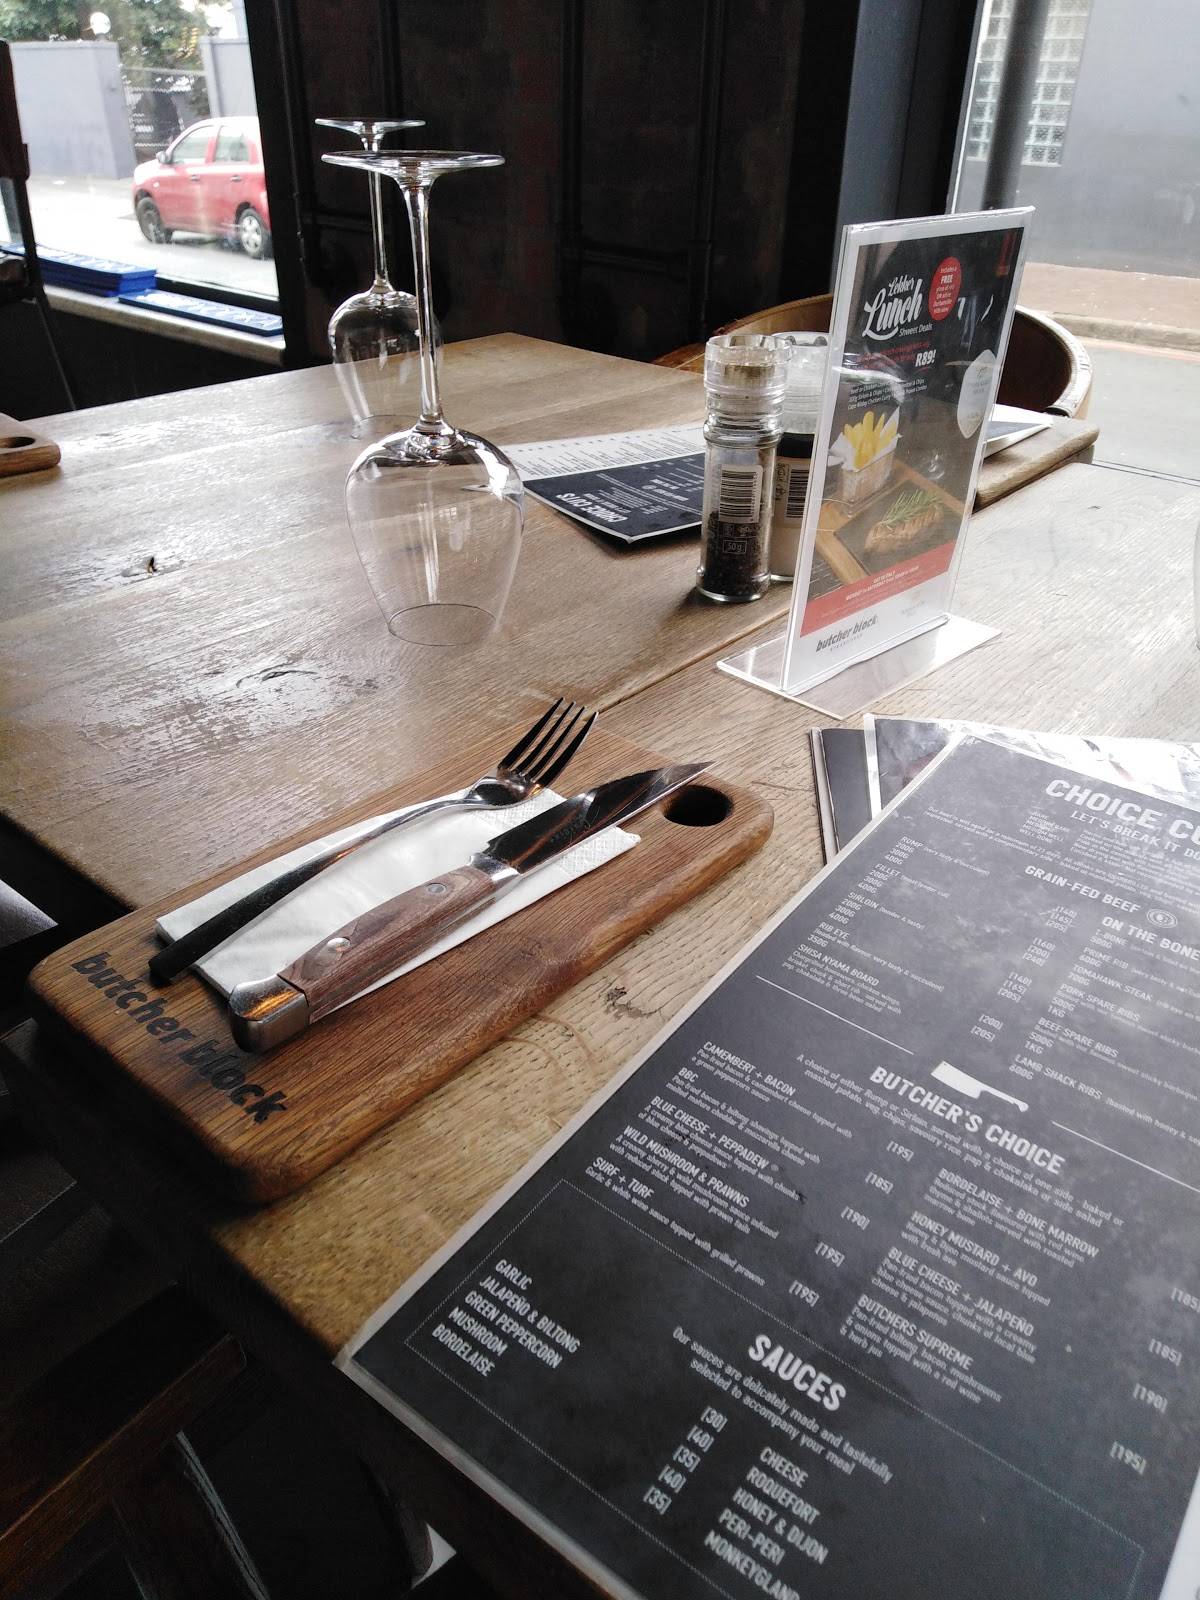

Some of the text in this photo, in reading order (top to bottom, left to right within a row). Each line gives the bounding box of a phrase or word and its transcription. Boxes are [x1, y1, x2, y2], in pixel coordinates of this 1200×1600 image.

[861, 278, 924, 341] Lunch
[915, 349, 937, 367] R89!
[815, 626, 852, 653] butcher
[853, 614, 878, 637] block
[1043, 777, 1163, 830] CHOICE
[900, 836, 923, 848] RUMP
[1069, 809, 1110, 829] LET'S
[1111, 823, 1160, 846] BREAK
[1163, 841, 1180, 853] IT
[874, 863, 900, 876] FILLET
[1023, 864, 1140, 915] GRAIN-FED BEEF
[847, 892, 879, 908] SIRLOIN
[818, 922, 849, 939] RIB EYE
[1101, 915, 1124, 931] ON
[1125, 924, 1157, 944] THE
[1159, 937, 1200, 961] BONE
[796, 944, 880, 986] SHISA NYAMA BOARD
[1086, 994, 1116, 1011] SPARE
[1118, 1007, 1140, 1021] RIBS
[1123, 985, 1152, 1002] STEAK
[70, 952, 288, 1124] butcher block
[1037, 1017, 1118, 1058] BEEF SPARE RIBS
[676, 1067, 698, 1083] BBC
[700, 1041, 755, 1074] CAMEMBERT
[762, 1074, 796, 1096] BACON
[1014, 1053, 1043, 1072] LAMB
[1078, 1083, 1103, 1100] RIBS
[649, 1095, 677, 1115] BLUE
[672, 1109, 710, 1134] CHEESE
[716, 1134, 770, 1169] PEPPADEW
[868, 1066, 1065, 1176] BUTCHER'S CHOICE
[591, 1156, 620, 1178] SURF
[626, 1177, 655, 1200] TURF
[620, 1125, 648, 1146] WILD
[643, 1139, 700, 1177] MUSHROOM
[706, 1176, 750, 1208] PRAWNS
[937, 1166, 1004, 1209] BORDELAISE
[1015, 1207, 1047, 1232] BONE
[1046, 1223, 1099, 1260] MARROW
[493, 1258, 533, 1291] GARLIC
[887, 1244, 920, 1271] BLUE
[916, 1261, 962, 1296] CHEESE
[910, 1209, 948, 1237] HONEY
[946, 1229, 1001, 1267] MUSTARD
[1012, 1265, 1038, 1288] AVO
[447, 1306, 509, 1357] MUSHROOM
[463, 1289, 563, 1369] GREEN PEPPERCORN
[478, 1272, 582, 1354] JALAPEÑO & BILTONG
[856, 1293, 973, 1372] BUTCHERS SUPREME
[430, 1322, 496, 1378] BORDELAISE
[745, 1332, 848, 1414] SAUCES
[670, 1325, 895, 1486] Our sauces are delicately made and tastefully
[689, 1356, 854, 1476] selected to accompany your meal
[758, 1445, 808, 1489] CHEESE
[744, 1464, 819, 1529] ROQUEFORT
[717, 1506, 785, 1567] PERI-PERI
[731, 1484, 828, 1567] HONEY & DIJON
